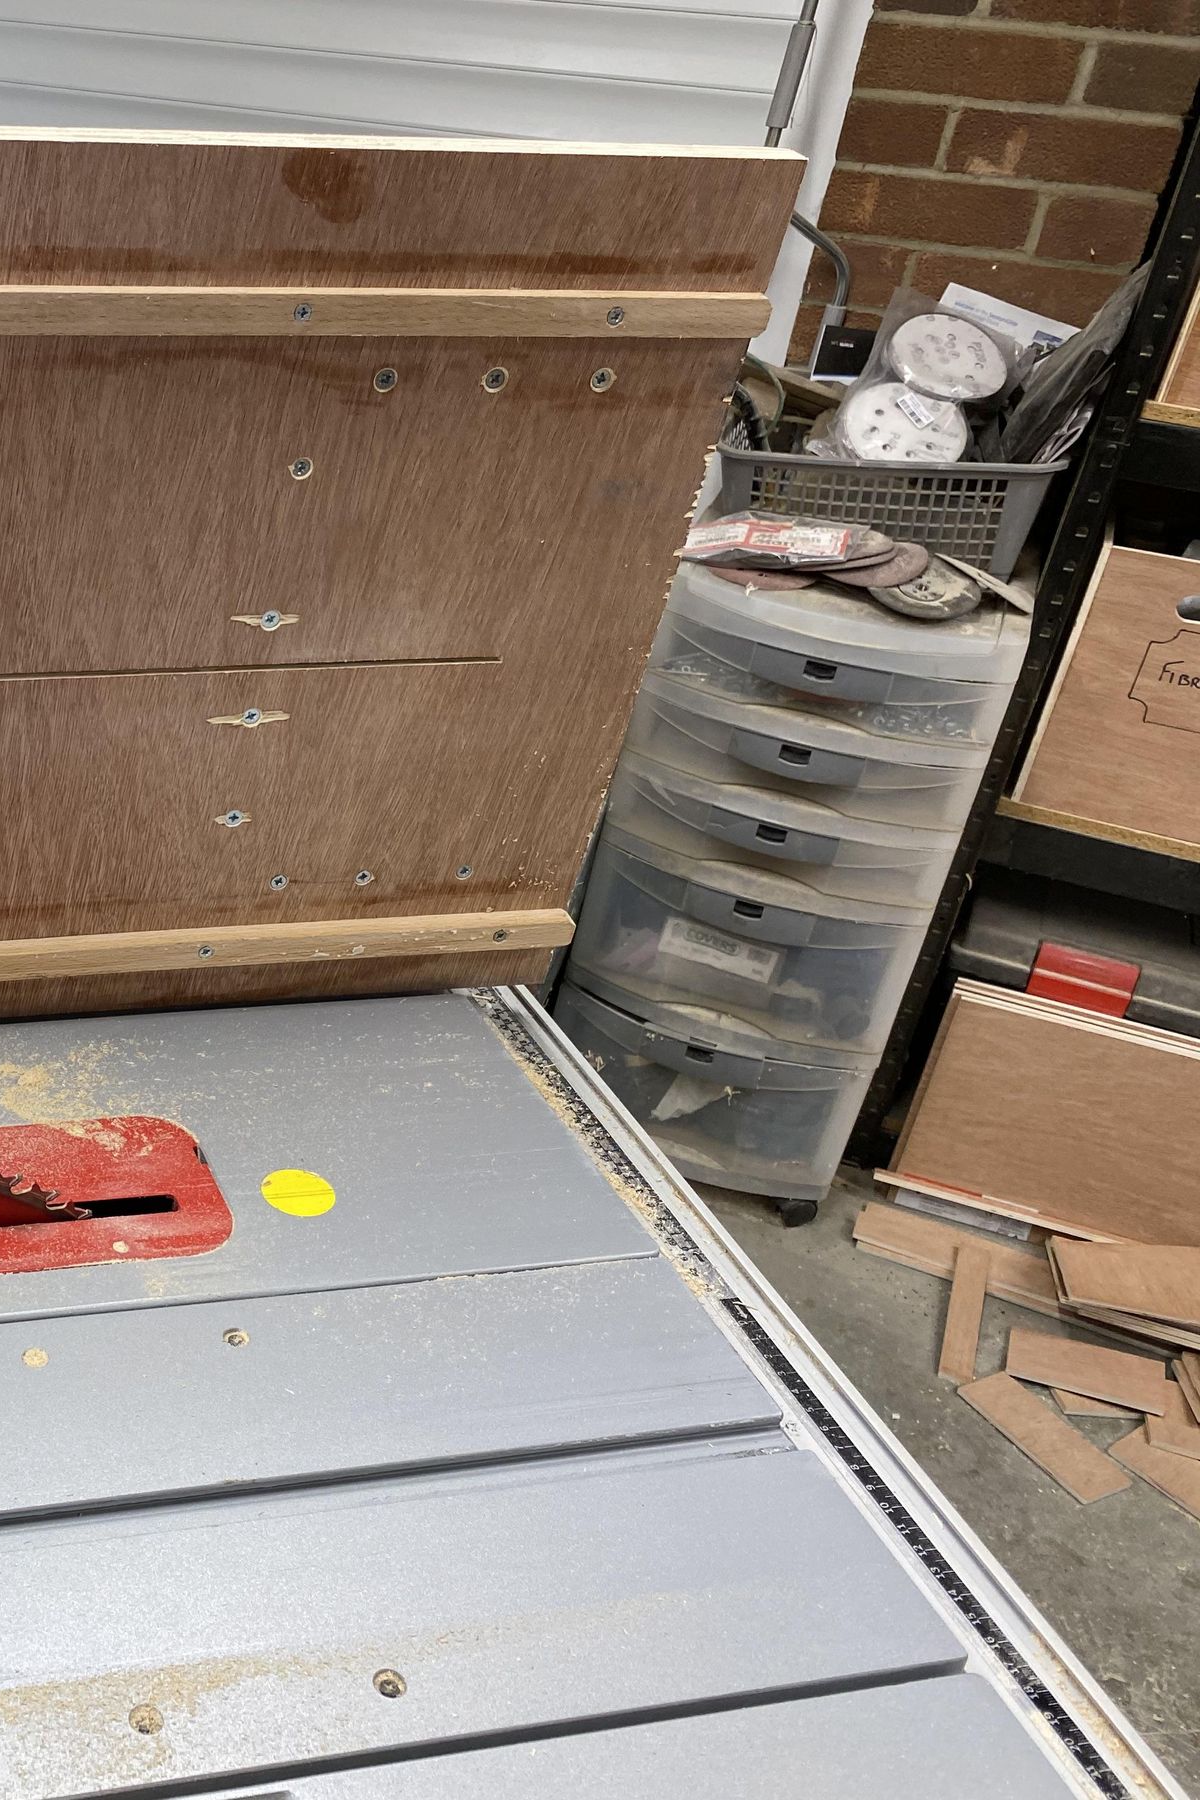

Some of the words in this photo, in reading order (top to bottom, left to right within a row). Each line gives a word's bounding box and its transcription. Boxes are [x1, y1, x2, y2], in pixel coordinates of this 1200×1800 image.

[880, 1502, 894, 1514] 10
[896, 1523, 911, 1535] 11
[912, 1544, 928, 1557] 12
[930, 1566, 946, 1579] 13
[947, 1589, 963, 1602] 14
[966, 1612, 982, 1625] 15
[984, 1636, 1001, 1649] 16
[1003, 1661, 1020, 1676] 17
[1023, 1685, 1040, 1700] 18
[1043, 1711, 1060, 1726] 19
[1064, 1737, 1083, 1754] 20
[1086, 1765, 1102, 1780] 21
